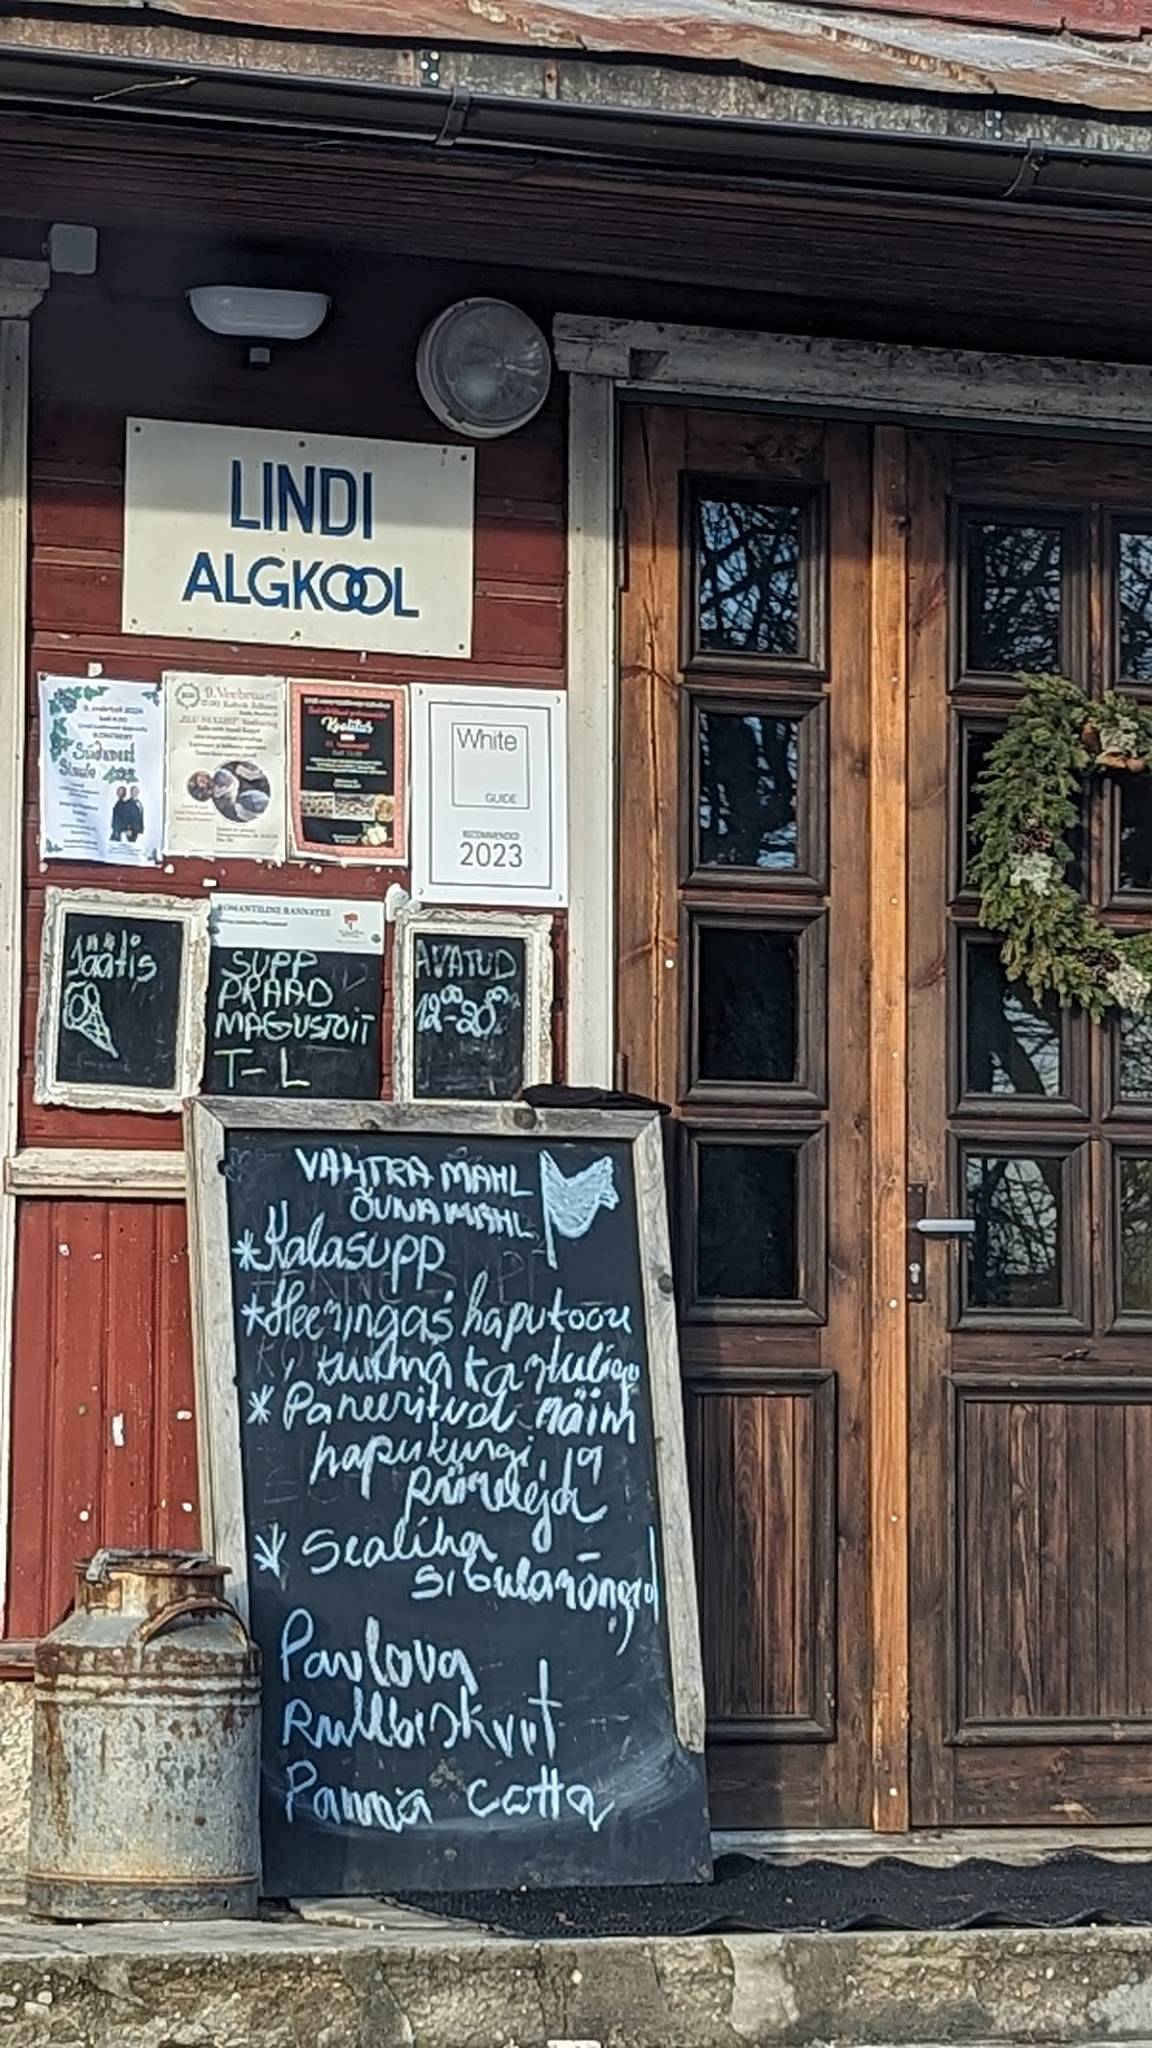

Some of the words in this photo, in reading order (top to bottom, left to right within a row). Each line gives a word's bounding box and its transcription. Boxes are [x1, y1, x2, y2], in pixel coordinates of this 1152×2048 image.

[231, 460, 372, 539] LINDI
[182, 552, 419, 618] ALGKOOL
[457, 728, 517, 751] White
[485, 793, 517, 804] GUIDE
[460, 842, 523, 868] 2023
[221, 950, 318, 979] SUPP
[415, 939, 517, 981] AVATUD
[218, 976, 333, 1011] PRAAD
[440, 1161, 534, 1197] MAHL
[280, 1608, 478, 1695] Pavlova
